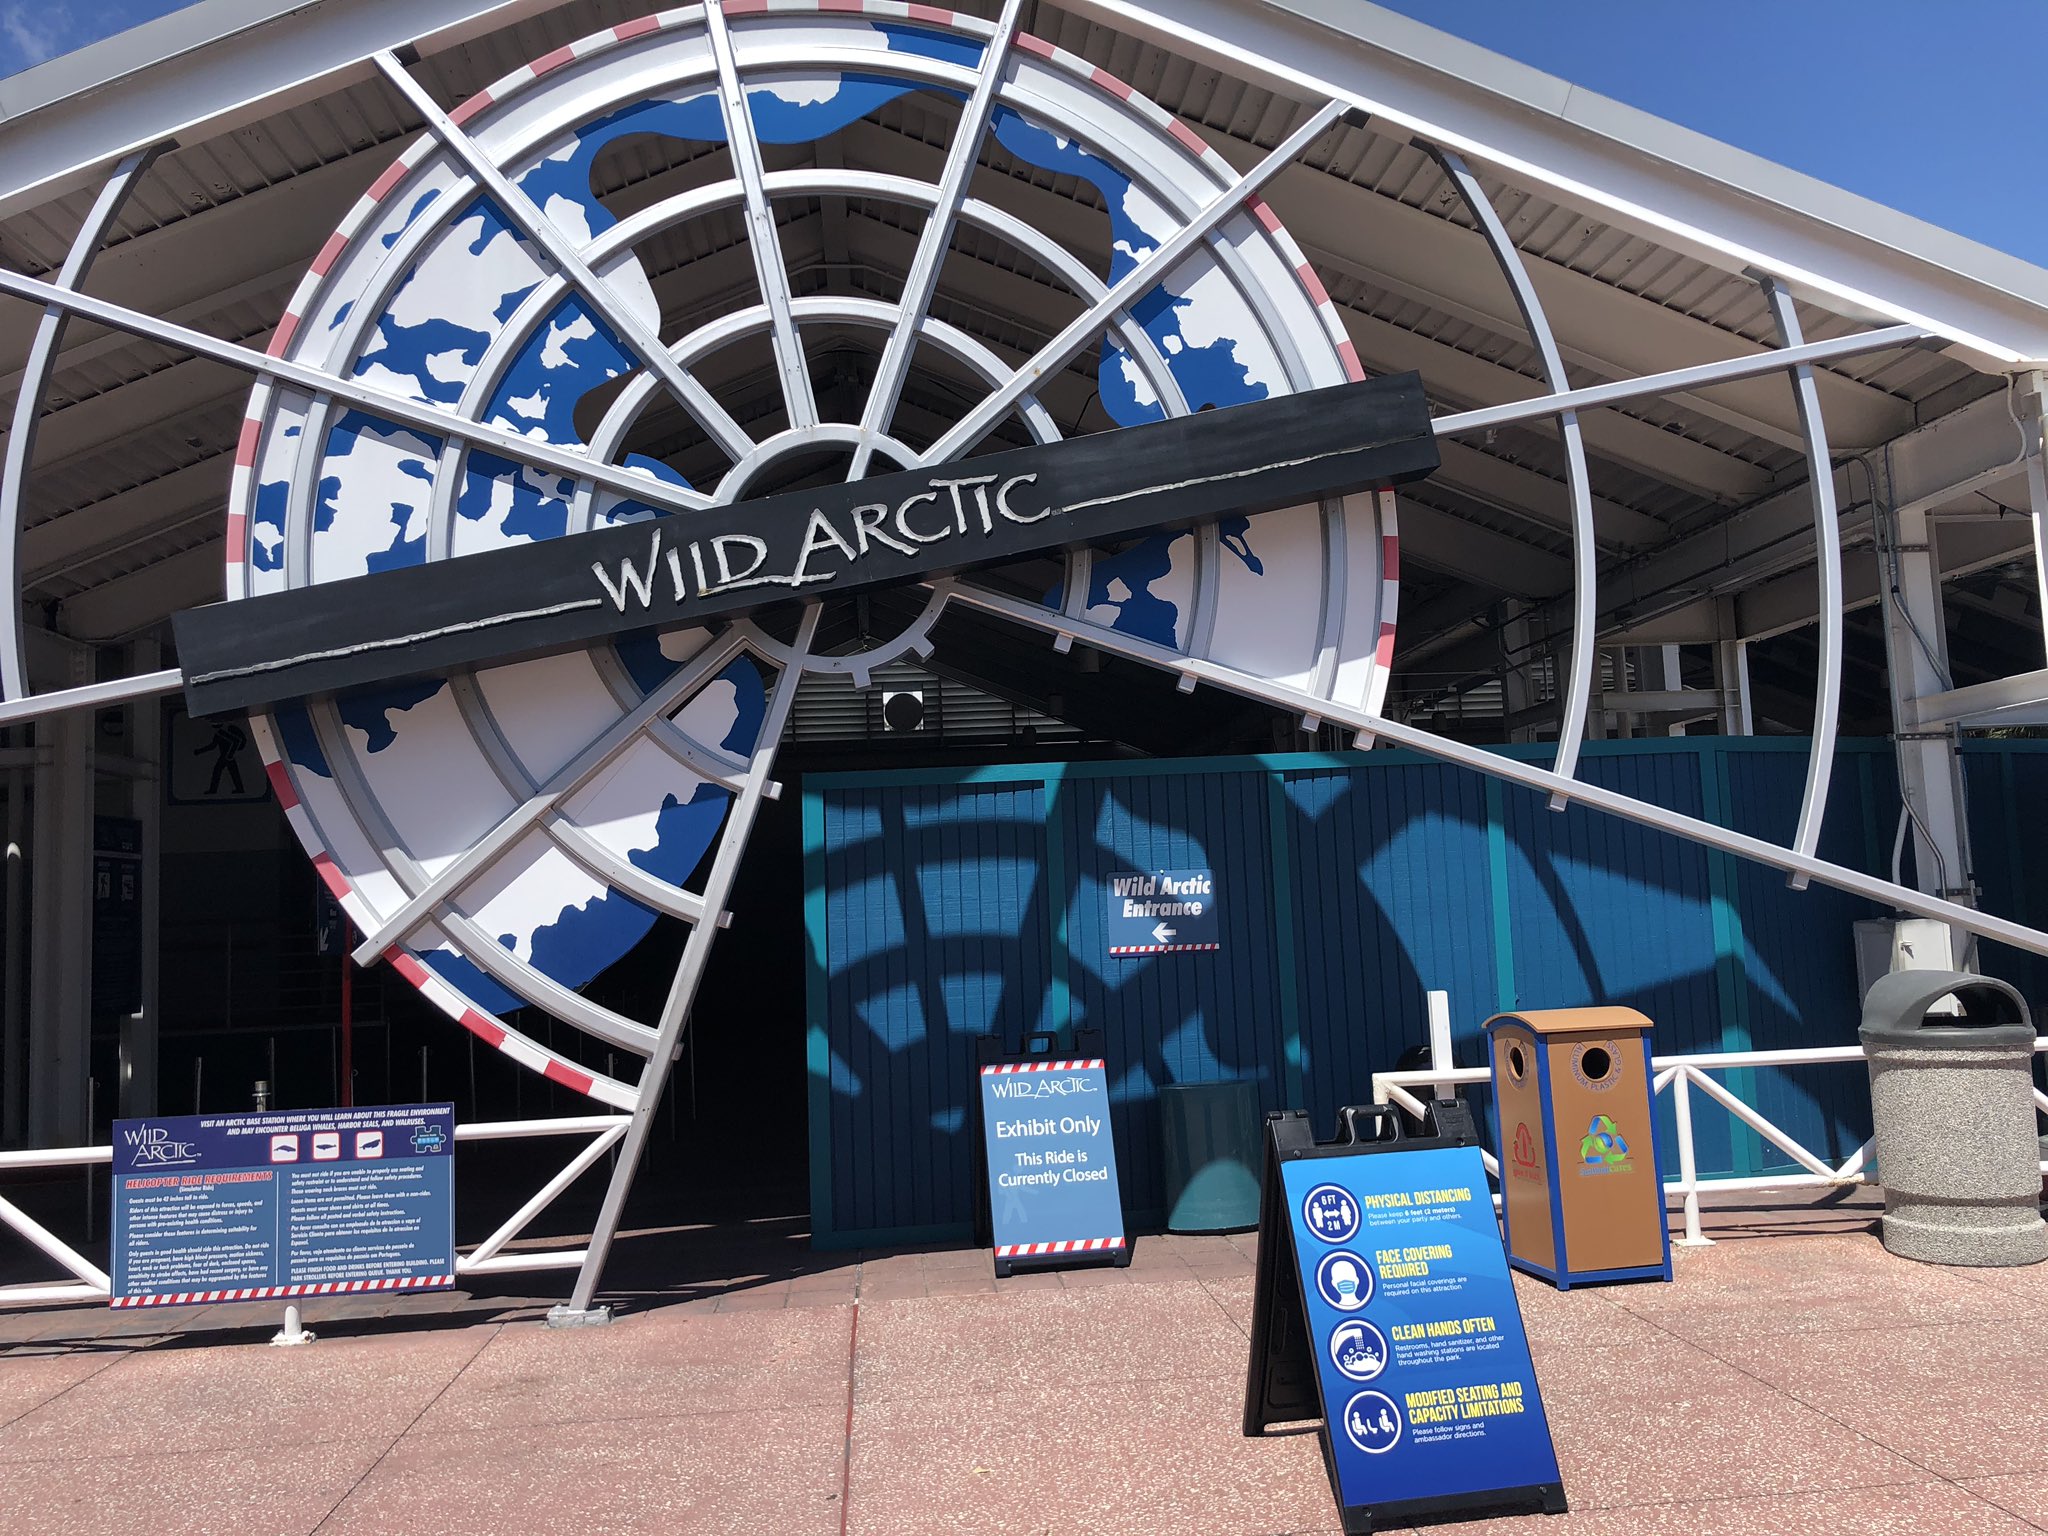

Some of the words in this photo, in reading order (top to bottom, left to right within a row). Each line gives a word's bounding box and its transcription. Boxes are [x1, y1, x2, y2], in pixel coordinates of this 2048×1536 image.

[592, 528, 767, 612] WILD
[792, 473, 1051, 588] ARCTIC
[1113, 876, 1156, 896] Wild
[1160, 874, 1211, 895] Arctic
[1122, 899, 1202, 918] Entrance
[1590, 1073, 1618, 1092] PLASTIC
[1607, 1041, 1622, 1066] GLASS
[992, 1077, 1032, 1098] WILD
[1034, 1077, 1092, 1099] ARCTIC
[124, 1123, 168, 1146] WILD
[996, 1119, 1056, 1138] Exhibit
[1060, 1115, 1100, 1136] Only
[131, 1144, 197, 1166] ARCTIC
[1015, 1152, 1043, 1166] This
[1045, 1150, 1074, 1164] Ride
[1077, 1150, 1088, 1162] is
[125, 1176, 180, 1189] HELICOPTER
[180, 1175, 203, 1186] RIDE
[203, 1171, 272, 1184] REQUIREMENTS
[998, 1170, 1060, 1186] Currently
[1063, 1166, 1108, 1182] Closed
[1320, 1195, 1327, 1205] 6
[1326, 1194, 1336, 1204] FT
[1364, 1192, 1413, 1209] PHYSICAL
[1413, 1187, 1472, 1205] DISTANCING
[1388, 1210, 1403, 1218] keep
[1431, 1206, 1456, 1214] meters)
[1326, 1221, 1333, 1230] 2
[1332, 1220, 1341, 1230] M
[1369, 1218, 1396, 1226] between
[1375, 1248, 1402, 1264] FACE
[1401, 1244, 1452, 1261] COVERING
[1378, 1261, 1429, 1279] REQUIRED
[1382, 1281, 1409, 1289] Personal
[1426, 1277, 1455, 1286] coverings
[1383, 1288, 1406, 1297] required
[1432, 1283, 1462, 1291] attraction
[1390, 1323, 1426, 1340] CLEAN
[1425, 1319, 1462, 1337] HANDS
[1462, 1316, 1496, 1333] OFTEN
[1394, 1342, 1430, 1352] Restrooms,
[1447, 1337, 1474, 1346] sanitizer,
[1413, 1348, 1439, 1358] washing
[1440, 1346, 1464, 1354] stations
[1476, 1342, 1499, 1350] located
[1397, 1356, 1433, 1367] throughout
[1445, 1353, 1461, 1362] park.
[1404, 1388, 1455, 1408] MODIFIED
[1455, 1383, 1499, 1402] SEATING
[1499, 1381, 1523, 1398] AND
[1407, 1404, 1460, 1424] CAPACITY
[1459, 1397, 1525, 1418] LIMITATIONS
[1411, 1427, 1433, 1435] Please
[1433, 1424, 1454, 1433] follow
[1454, 1422, 1471, 1432] signs
[1413, 1432, 1452, 1443] ambassador
[1453, 1428, 1486, 1438] directions.
